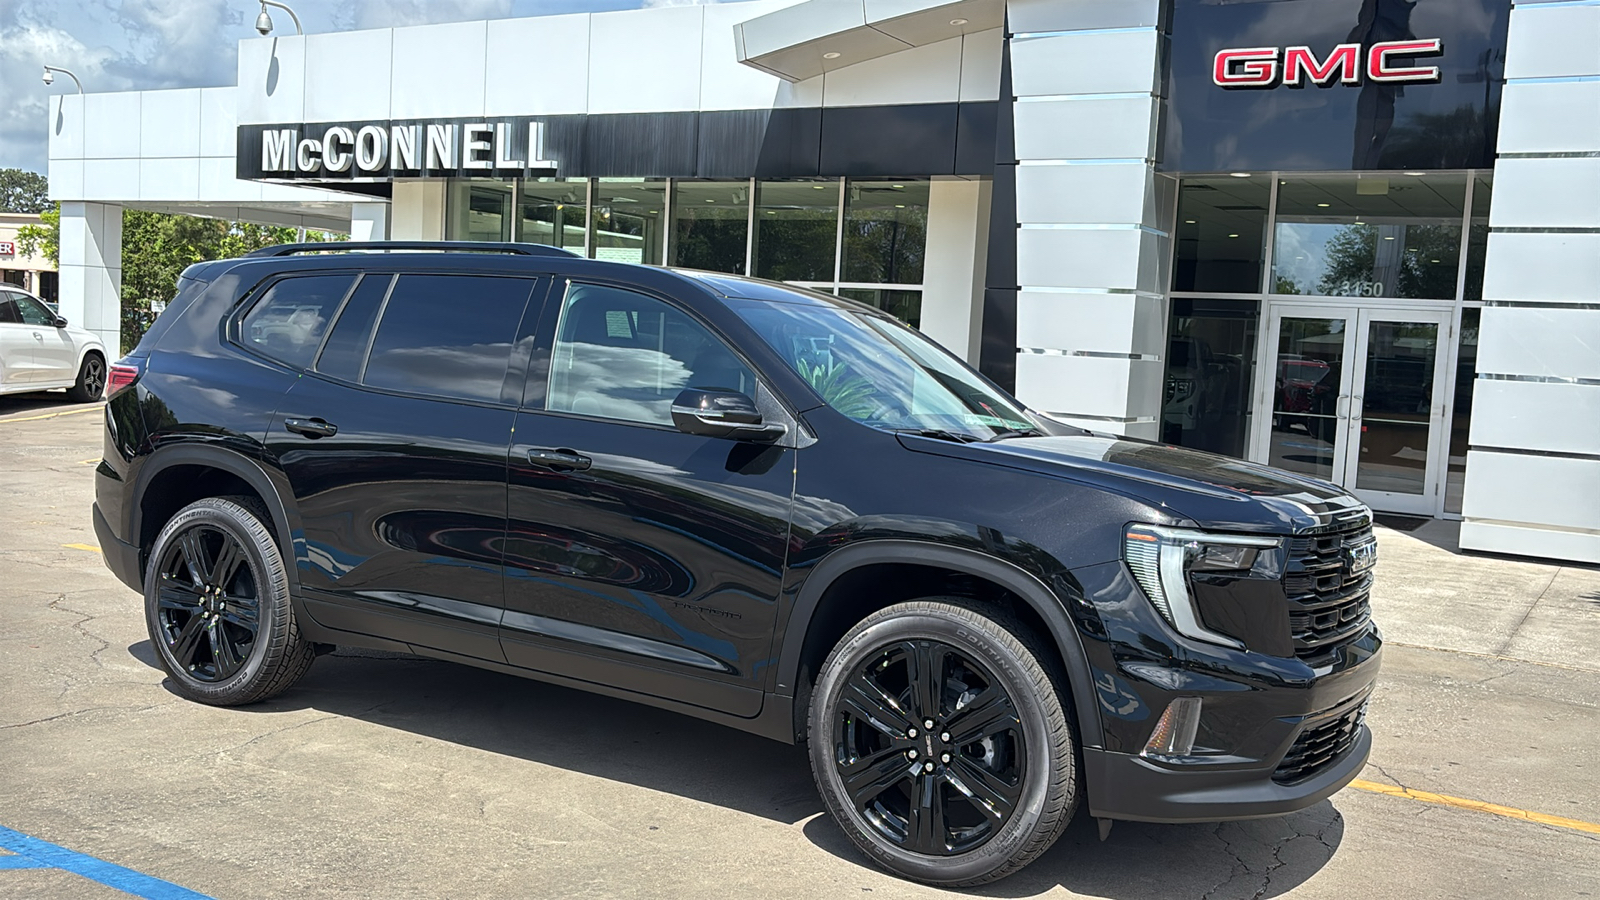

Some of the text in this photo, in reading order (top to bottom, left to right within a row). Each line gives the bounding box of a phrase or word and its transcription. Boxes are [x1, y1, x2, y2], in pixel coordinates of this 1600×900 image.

[1213, 38, 1440, 86] GMC
[262, 121, 557, 171] McCONNELL
[1341, 281, 1384, 297] 3150
